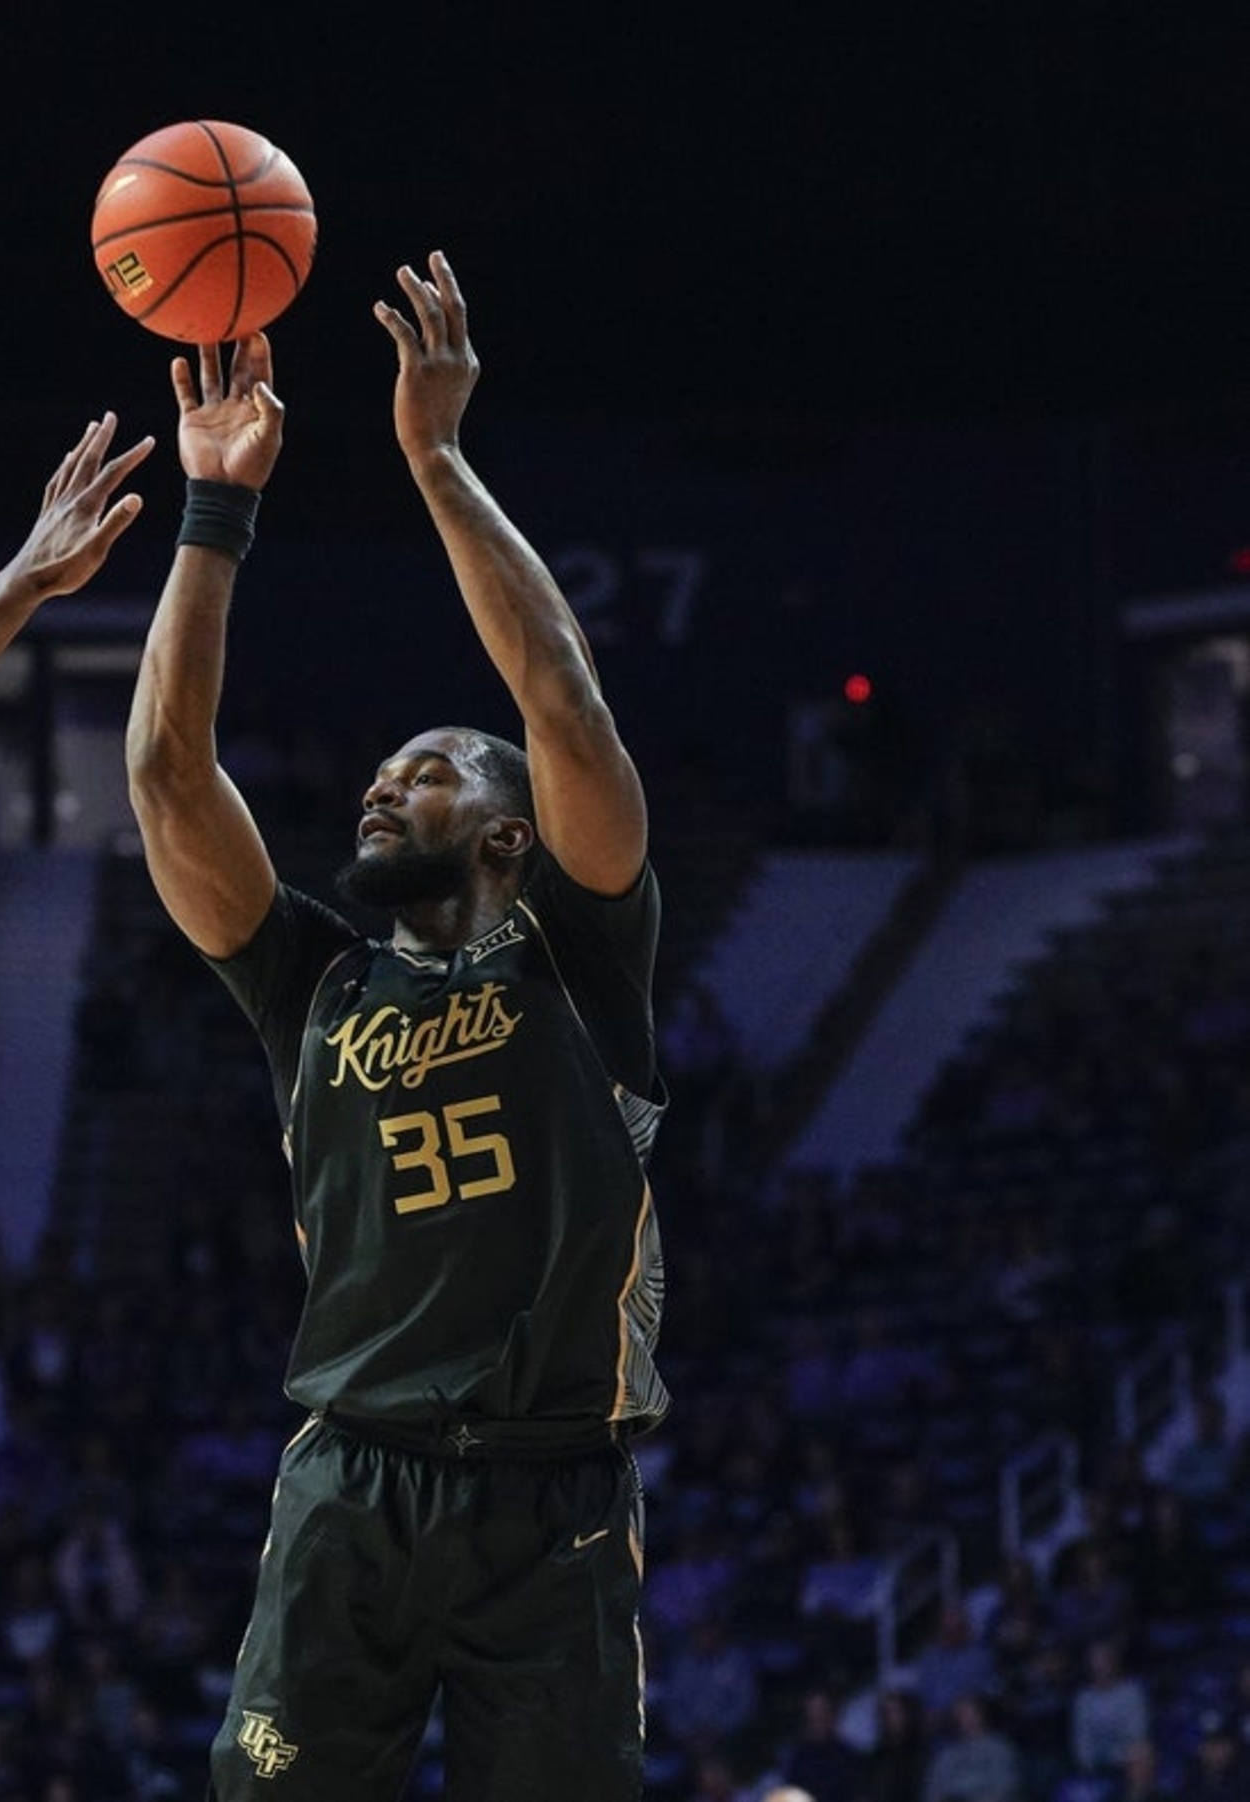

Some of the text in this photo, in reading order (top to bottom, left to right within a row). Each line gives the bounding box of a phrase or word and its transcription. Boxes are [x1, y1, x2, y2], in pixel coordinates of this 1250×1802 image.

[554, 546, 706, 646] 27
[326, 981, 523, 1091] Knights
[378, 1095, 516, 1215] 35
[237, 1710, 298, 1779] UCF
